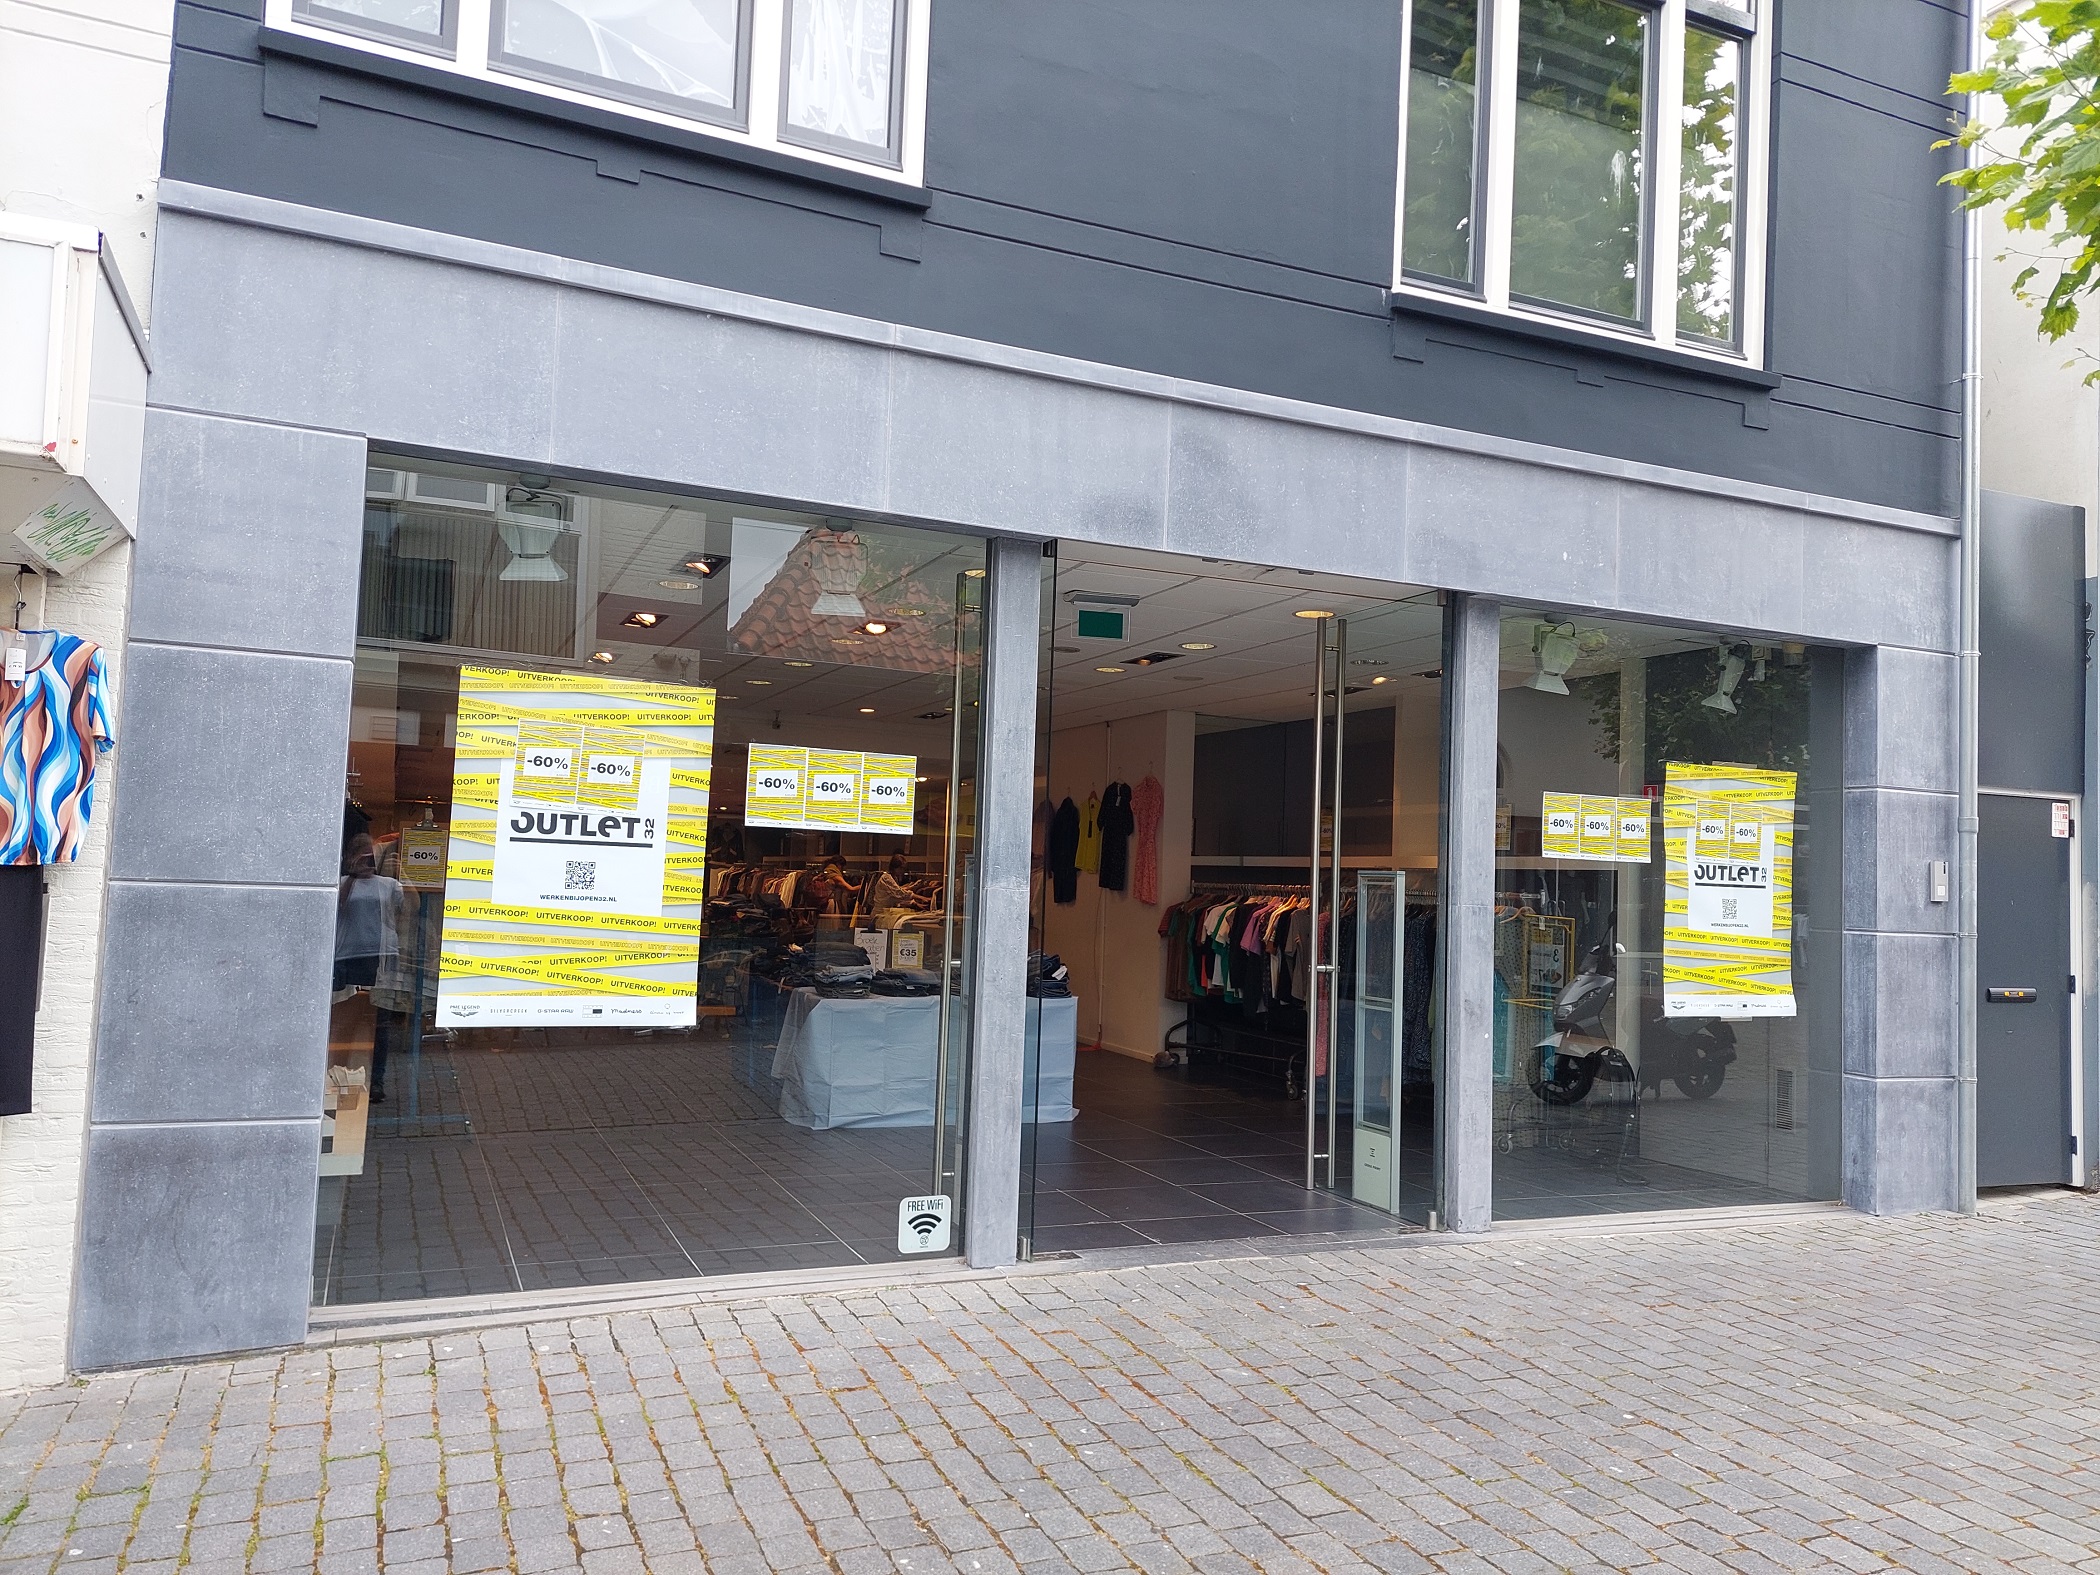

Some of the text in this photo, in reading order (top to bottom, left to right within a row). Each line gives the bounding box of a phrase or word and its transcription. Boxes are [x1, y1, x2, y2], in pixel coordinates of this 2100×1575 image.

[517, 672, 576, 682] UITVERK
[637, 713, 692, 721] UITVERKOOP!
[527, 755, 568, 770] -60%
[591, 763, 631, 777] -60%
[758, 777, 795, 790] -60%
[815, 781, 851, 794] -60%
[871, 785, 905, 797] -60%
[644, 818, 655, 839] 32
[1549, 818, 1573, 829] -60%
[1586, 821, 1610, 831] -60%
[1622, 823, 1645, 833] -60%
[1701, 825, 1724, 835] -60%
[1735, 828, 1757, 838] -60%
[409, 851, 439, 861] -60%
[468, 906, 529, 918] UITVERKOOP!
[536, 911, 594, 923] UITVERKOOP!
[600, 917, 657, 928] UITVERKOOP!
[900, 948, 917, 957] €35
[549, 955, 607, 966] UITVERKOOP!
[480, 962, 540, 976] UITVERKOOP!
[546, 971, 604, 985] UITVERKOOP!
[610, 980, 666, 994] UITVERKOOP!
[907, 1200, 925, 1212] FREE
